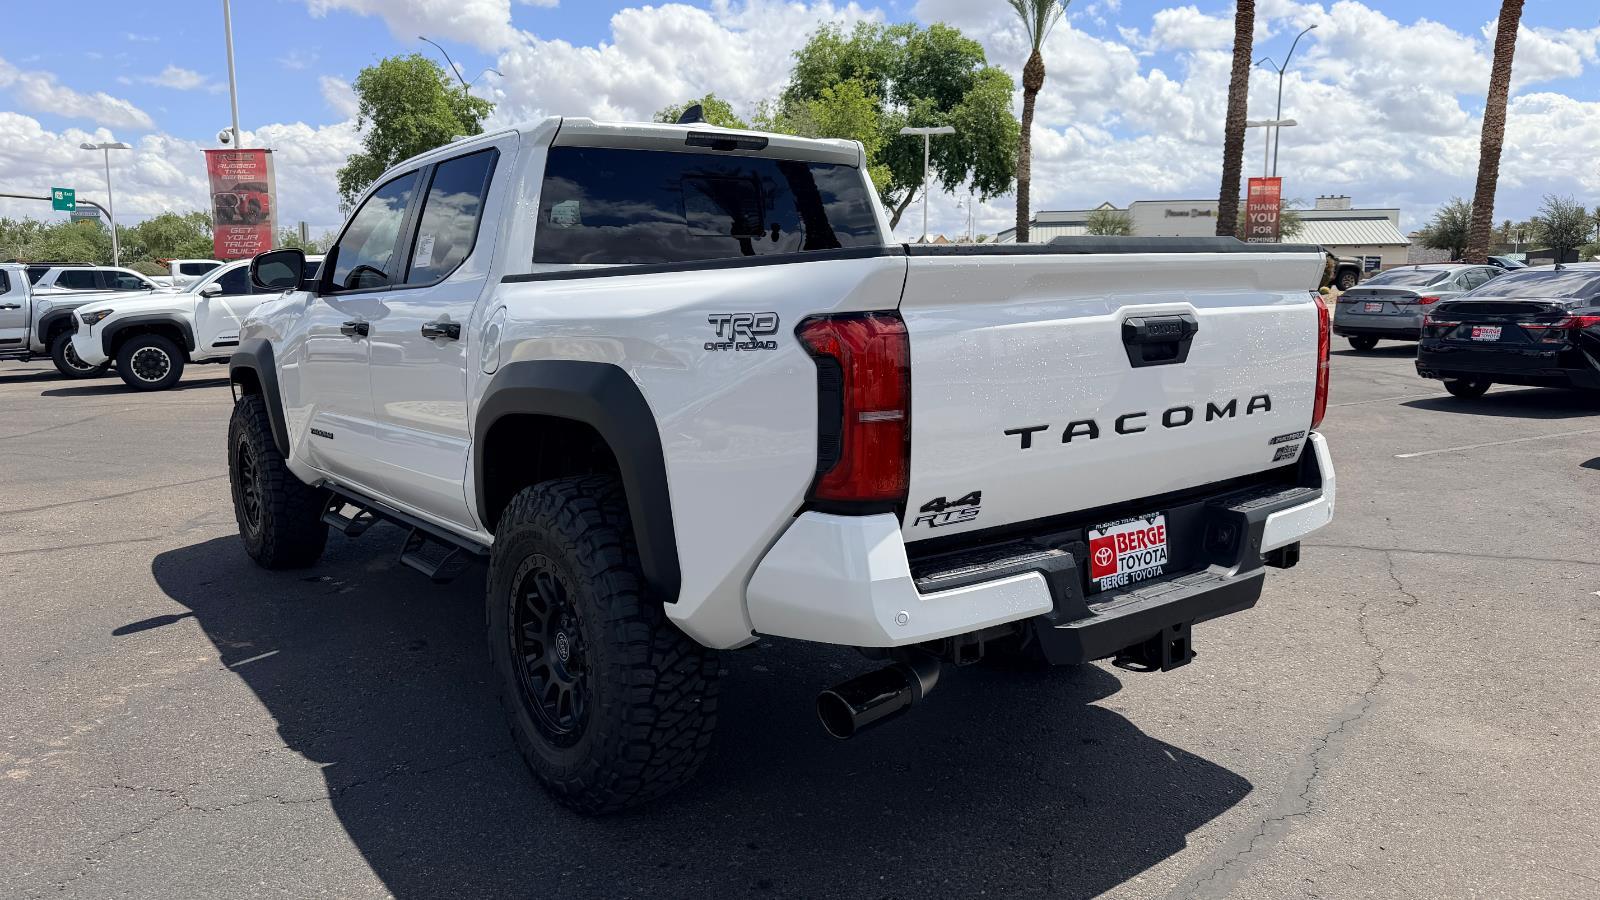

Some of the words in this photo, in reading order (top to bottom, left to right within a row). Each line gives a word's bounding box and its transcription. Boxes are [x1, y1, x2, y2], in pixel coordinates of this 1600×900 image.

[1249, 203, 1278, 211] THANK
[1249, 212, 1277, 223] YOU
[1252, 225, 1272, 234] FOR
[708, 312, 780, 342] TRD
[1148, 322, 1181, 335] TOYOTA
[704, 342, 734, 351] OFF
[736, 341, 778, 351] ROAD
[1003, 394, 1271, 449] TACOMA
[1116, 525, 1166, 554] BERGE
[1119, 547, 1167, 571] TOYOTA
[1100, 572, 1129, 591] BERGE
[1130, 566, 1163, 582] TOYOTA
